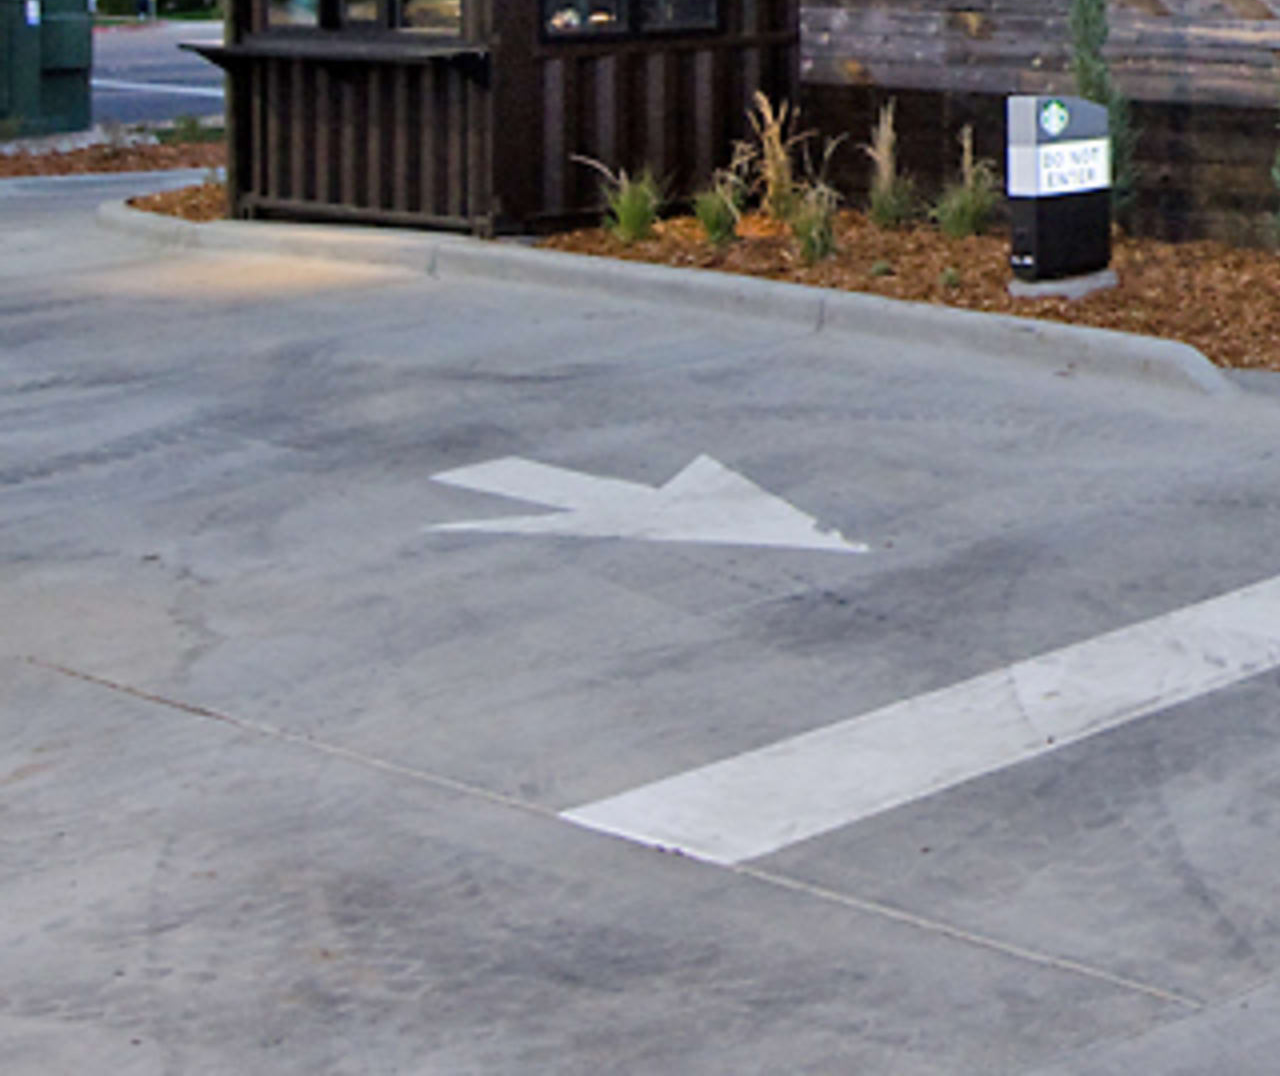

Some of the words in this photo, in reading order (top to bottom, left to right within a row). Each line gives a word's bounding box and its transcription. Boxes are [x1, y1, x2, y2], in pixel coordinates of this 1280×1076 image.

[1043, 150, 1064, 168] DO
[1070, 146, 1100, 165] NOT
[1047, 167, 1097, 188] ENTER
